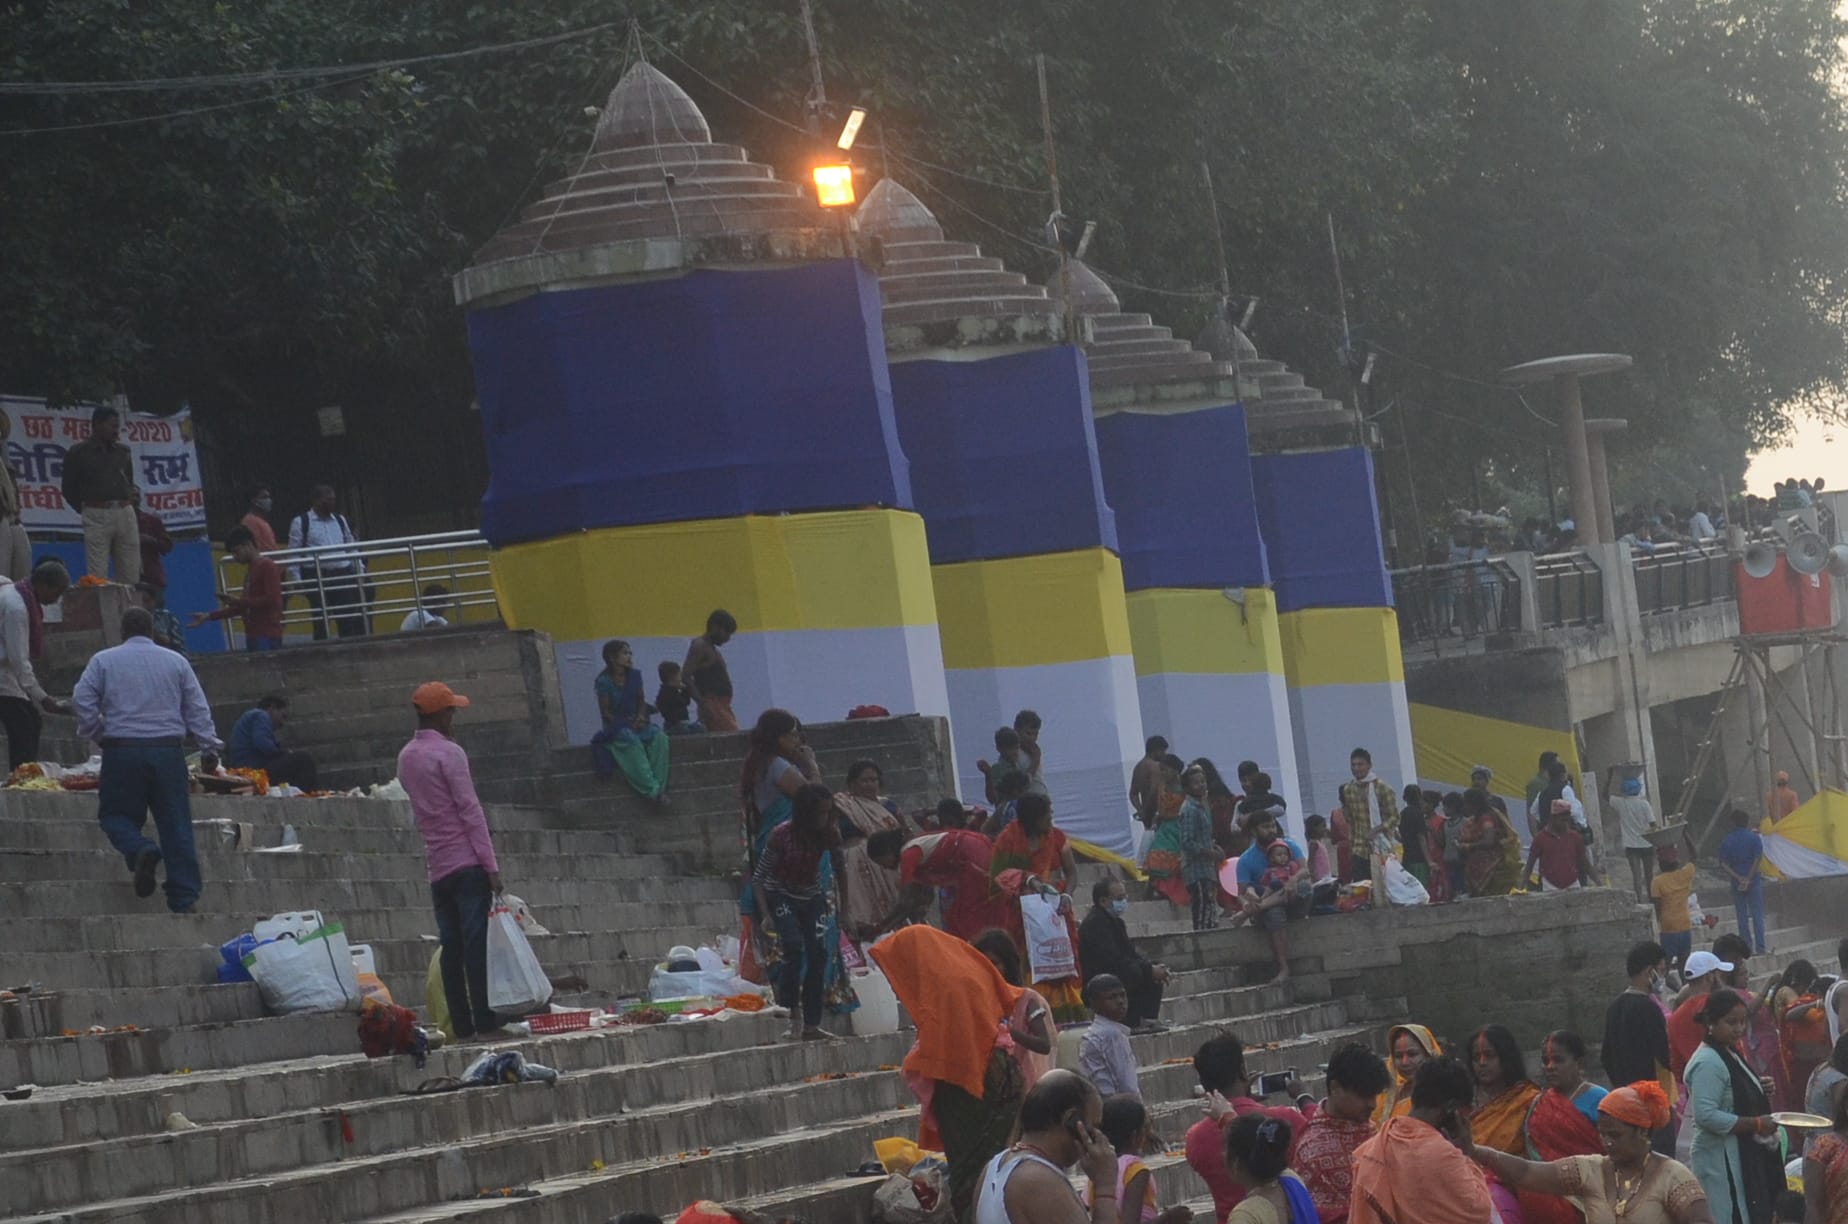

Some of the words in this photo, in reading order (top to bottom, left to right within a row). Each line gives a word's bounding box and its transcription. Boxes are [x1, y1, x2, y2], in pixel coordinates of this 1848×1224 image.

[21, 415, 55, 440] छठ
[140, 453, 191, 486] रूम
[145, 488, 204, 511] पटना
